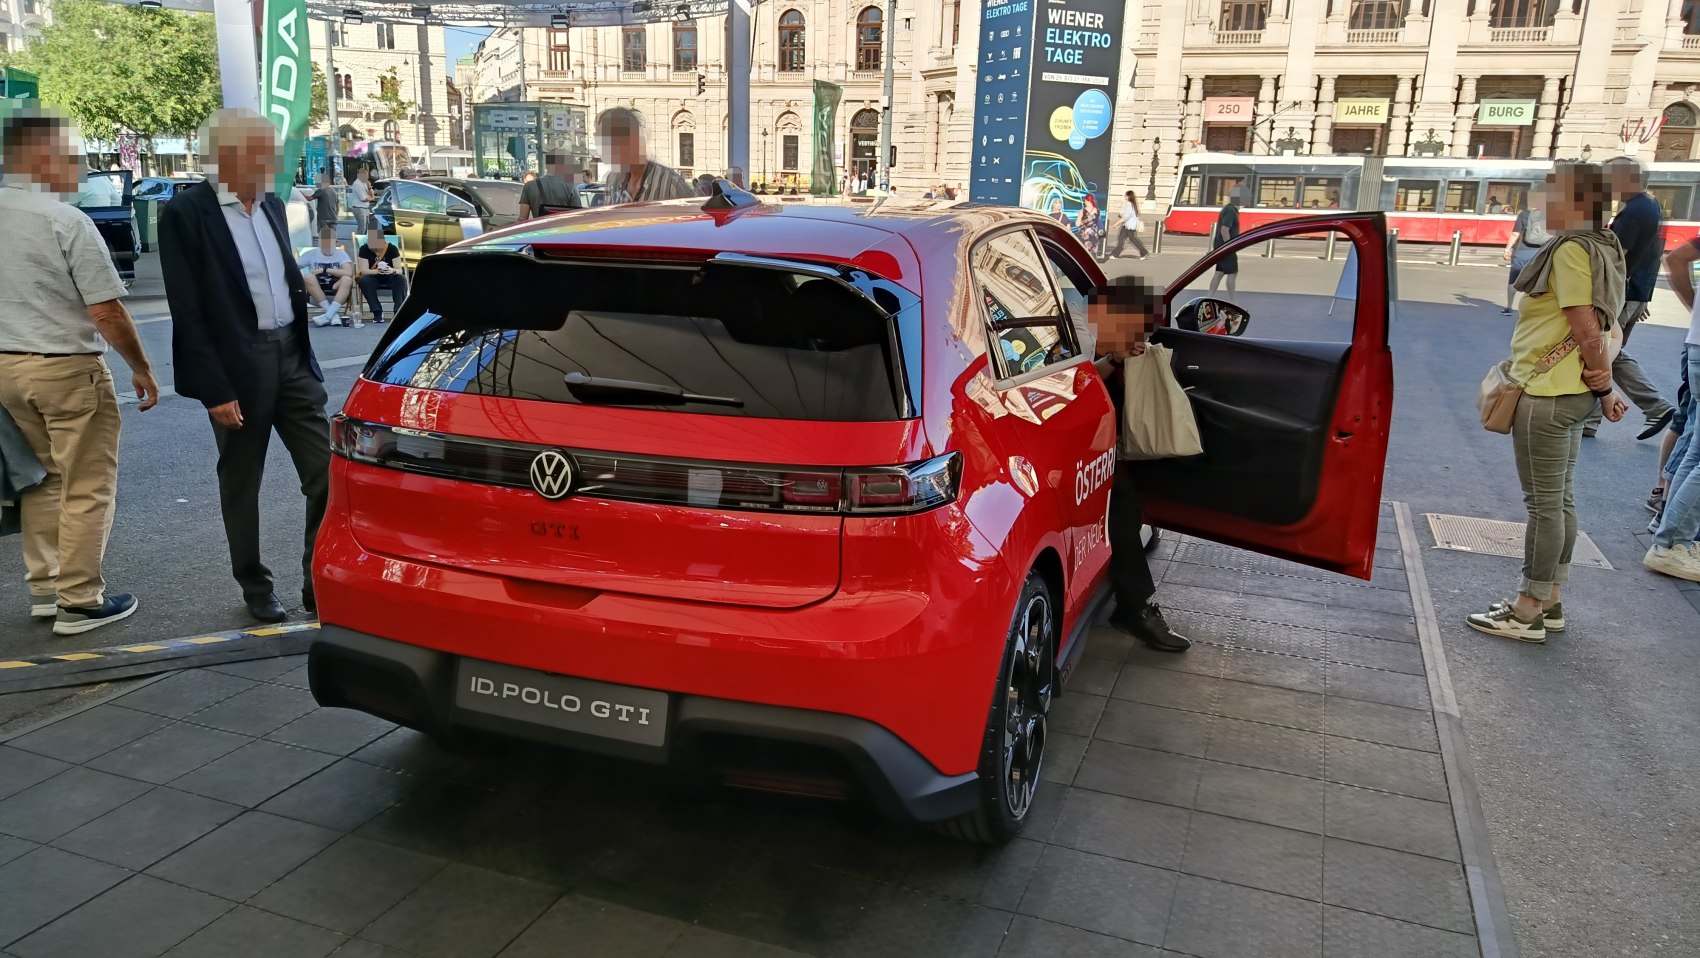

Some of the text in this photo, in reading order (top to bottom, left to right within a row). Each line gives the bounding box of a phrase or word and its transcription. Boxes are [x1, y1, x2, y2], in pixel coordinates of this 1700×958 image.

[986, 1, 1028, 19] ELEKTRO TAGE
[1047, 8, 1104, 29] WIENER
[1045, 27, 1111, 48] ELEKTRO
[1045, 46, 1084, 65] TAGE
[1217, 103, 1241, 115] 250
[1344, 104, 1381, 117] JAHRE
[1487, 105, 1525, 118] BURG
[530, 520, 580, 540] GTI
[1073, 534, 1087, 572] DER
[1087, 515, 1104, 554] NEUE
[590, 700, 650, 725] GTI
